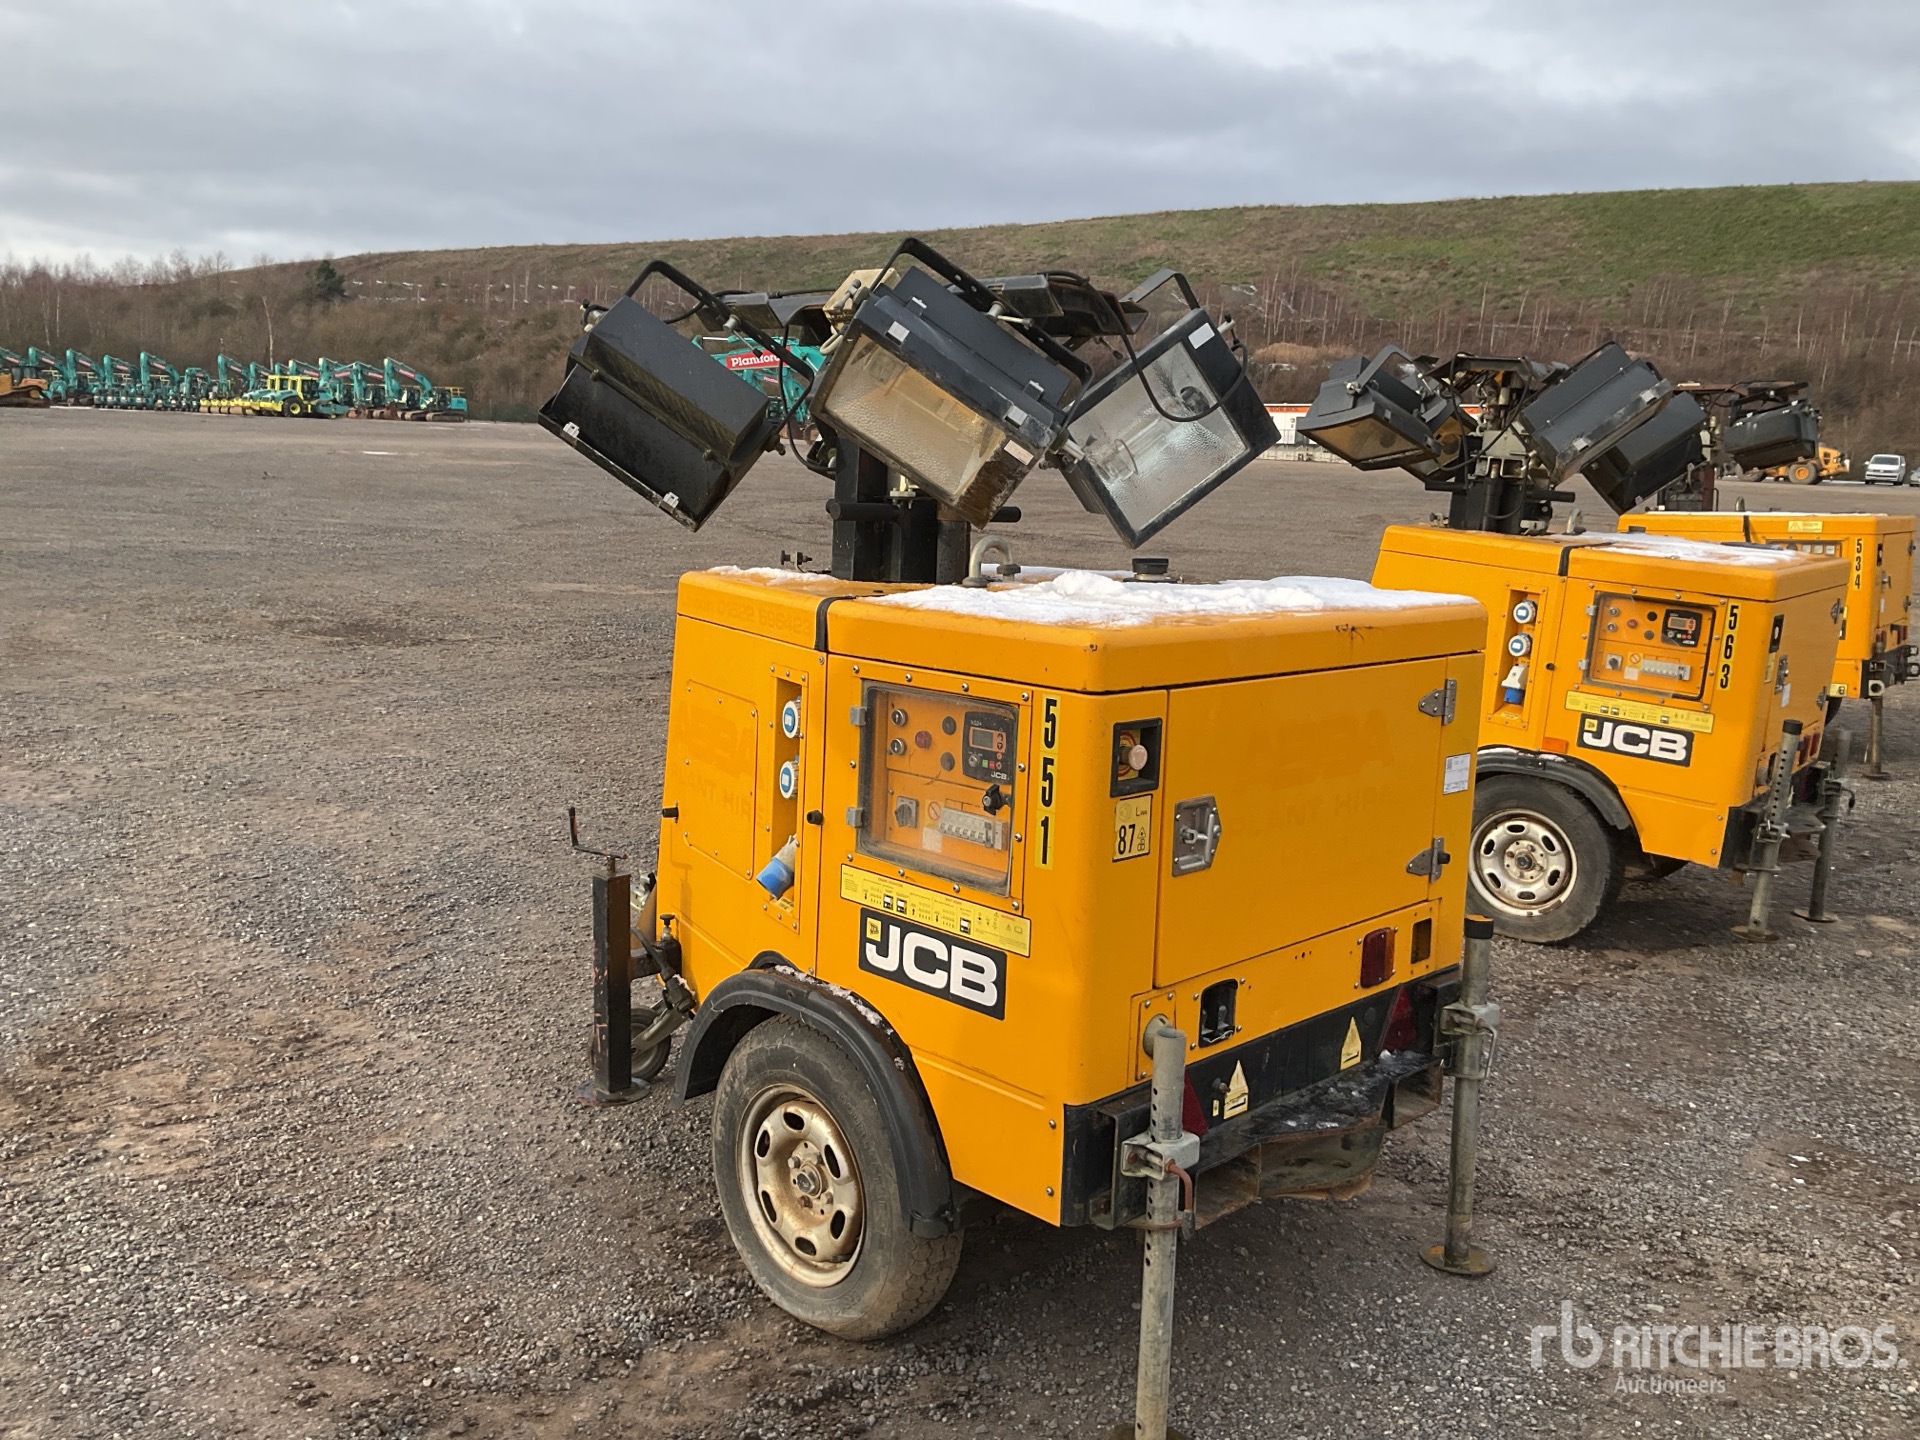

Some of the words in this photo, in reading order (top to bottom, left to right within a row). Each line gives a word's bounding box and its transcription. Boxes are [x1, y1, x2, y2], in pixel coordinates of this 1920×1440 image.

[1854, 538, 1863, 590] 534
[1720, 604, 1740, 690] 563
[1582, 721, 1688, 761] JCB
[990, 771, 1008, 780] JCB
[1039, 697, 1058, 866] 551
[1117, 823, 1136, 855] 87
[865, 924, 998, 1007] JCB
